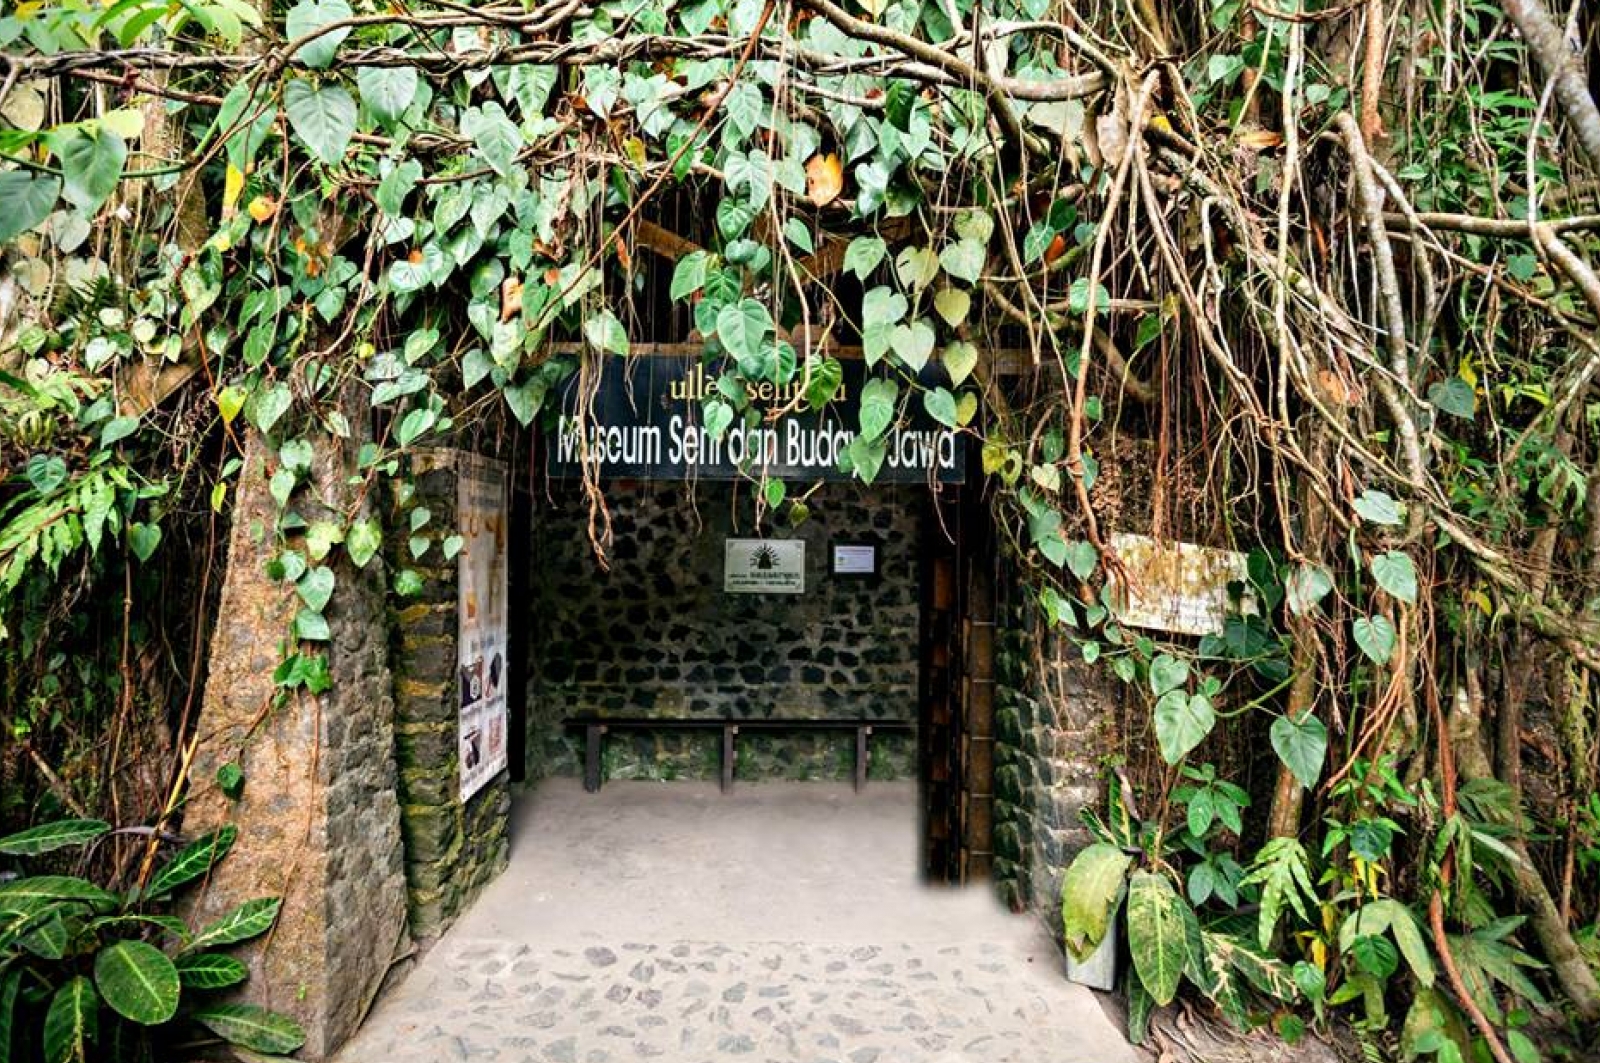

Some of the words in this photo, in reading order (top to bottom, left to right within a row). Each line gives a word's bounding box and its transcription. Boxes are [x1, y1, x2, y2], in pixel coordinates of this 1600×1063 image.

[557, 415, 662, 464] Museum
[728, 418, 780, 466] dan
[888, 428, 956, 469] Jawa
